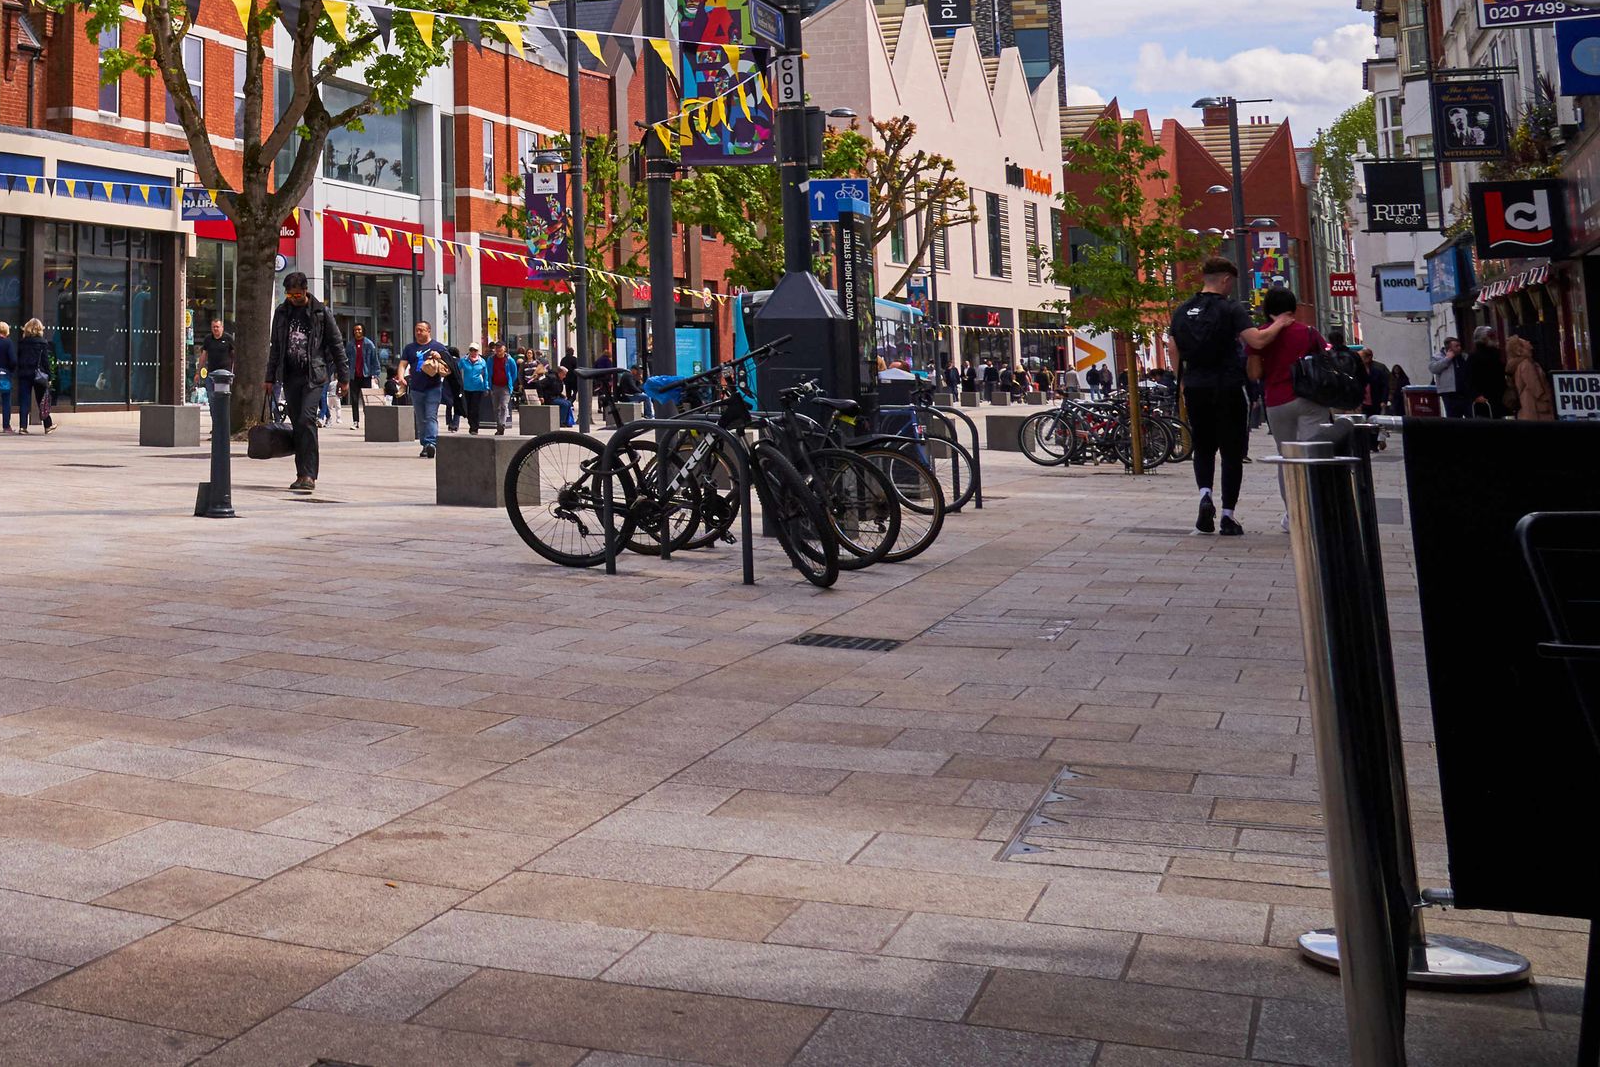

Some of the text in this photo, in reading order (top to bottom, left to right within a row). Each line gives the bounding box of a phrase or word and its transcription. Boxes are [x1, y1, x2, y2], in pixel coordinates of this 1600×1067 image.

[1489, 6, 1520, 20] 020
[1524, 2, 1566, 16] 7499
[183, 199, 218, 208] HALIFA
[1372, 204, 1420, 221] RIFT
[280, 226, 295, 236] ilko
[354, 225, 390, 258] wilko
[843, 228, 854, 320] WATFORD HIGH STREET
[1383, 278, 1417, 288] KOKOR
